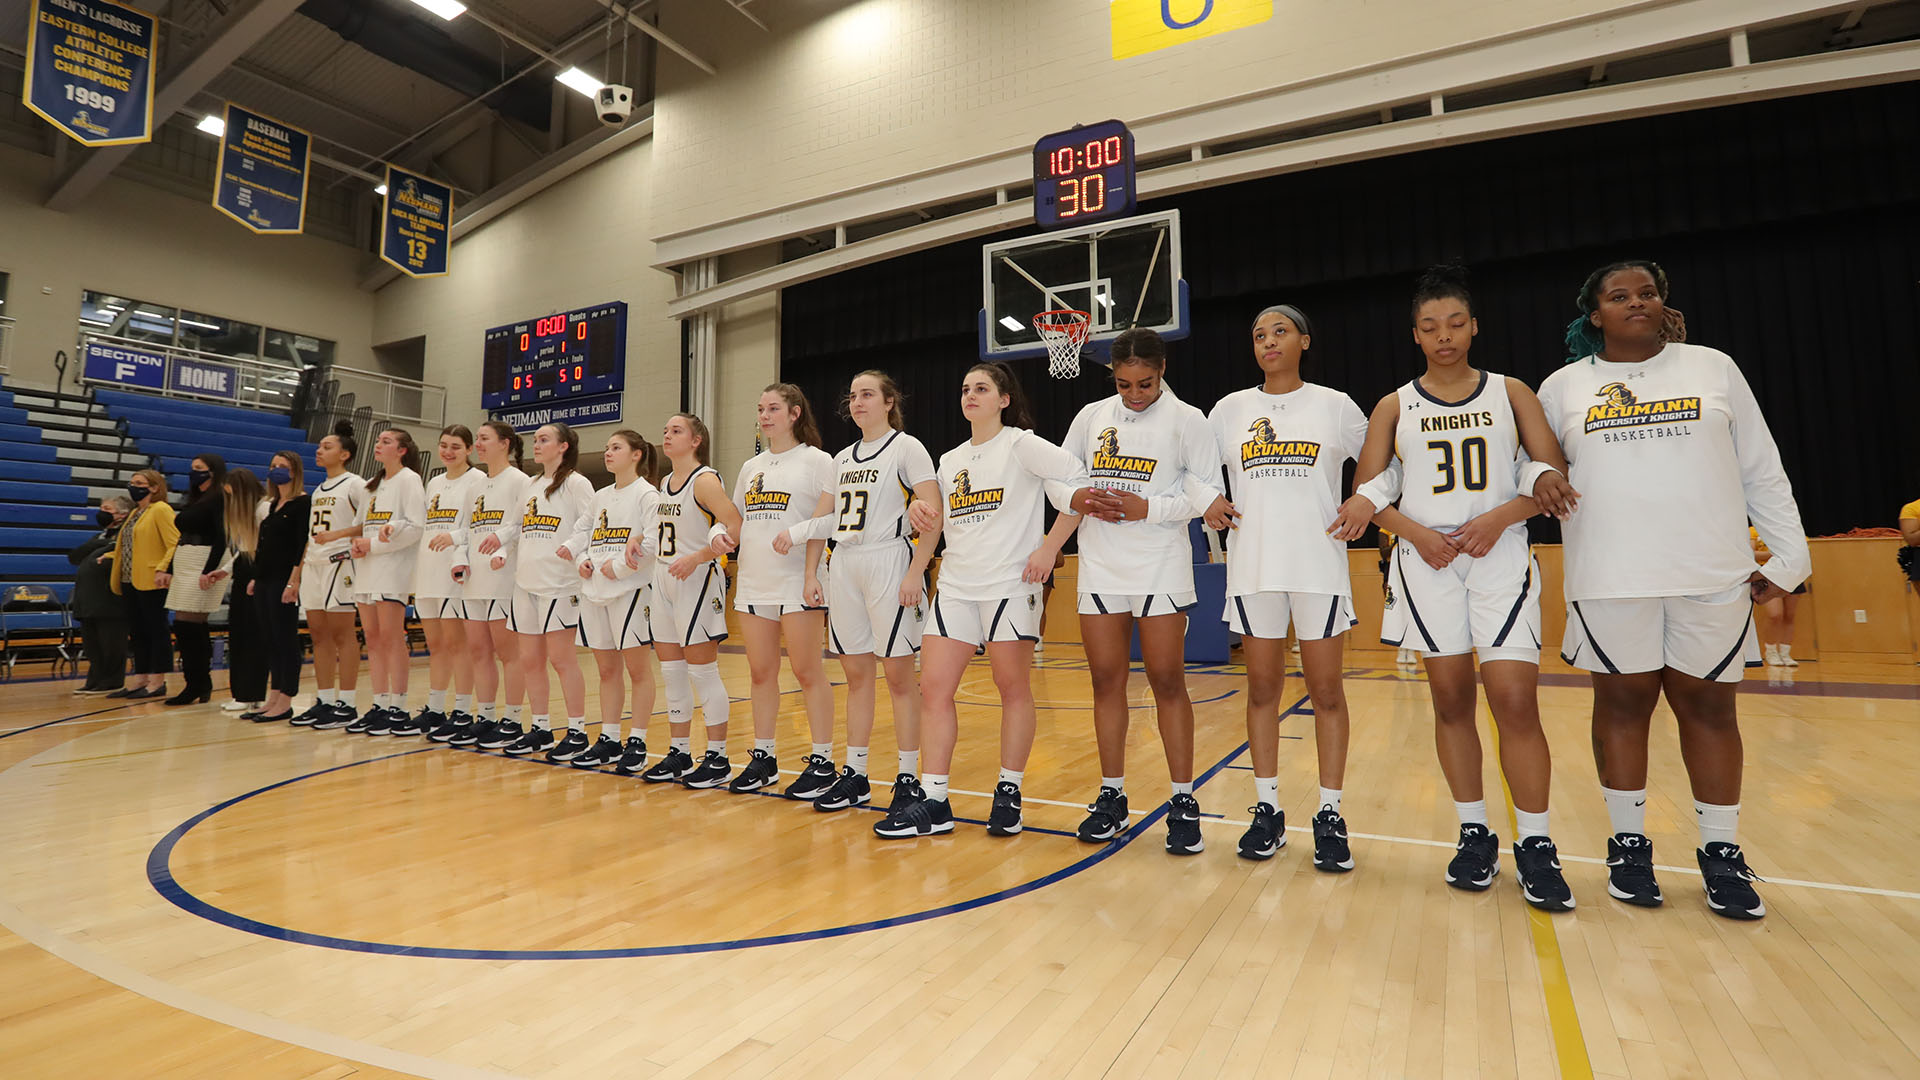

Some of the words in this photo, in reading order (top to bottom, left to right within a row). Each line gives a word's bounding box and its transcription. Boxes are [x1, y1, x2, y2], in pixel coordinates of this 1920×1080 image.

[89, 8, 142, 36] LACROSSE
[40, 11, 96, 40] EASTERN
[98, 32, 148, 58] COLLEGE
[65, 35, 123, 62] ATHLETIC
[53, 44, 132, 80] CONFERENCE
[54, 59, 130, 92] CHAMPIONS
[64, 84, 116, 113] 1999
[247, 118, 290, 143] BASEBALL
[1050, 136, 1120, 175] 10:00
[1060, 174, 1104, 217] 30
[410, 220, 427, 232] TEAM
[408, 239, 428, 260] 13
[536, 314, 566, 336] 10:00
[569, 312, 586, 322] Guests
[514, 325, 528, 334] Home
[577, 322, 587, 340] 0
[520, 333, 530, 352] 0
[540, 345, 554, 356] period
[561, 341, 566, 353] 1
[90, 346, 162, 368] SECTION
[539, 360, 554, 370] player
[115, 362, 136, 380] F
[180, 366, 228, 392] HOME
[514, 376, 522, 390] 0
[525, 374, 533, 388] 5
[560, 368, 567, 383] 5
[574, 366, 582, 380] 0
[539, 389, 552, 398] game
[552, 410, 568, 420] HOME
[569, 408, 576, 418] OF
[578, 406, 590, 416] THE
[591, 402, 618, 414] KNIGHTS
[1587, 398, 1698, 422] NEUMANN
[1420, 411, 1493, 432] KNIGHTS
[1586, 415, 1648, 430] UNIVERSITY
[1650, 411, 1697, 422] KNIGHTS
[1604, 426, 1692, 442] BASKETBALL
[1242, 442, 1318, 460] NEUMANN
[1282, 456, 1314, 464] KNIGHTS
[1093, 452, 1155, 472] NEUMANN
[1427, 436, 1488, 495] 30
[840, 470, 879, 485] KNIGHTS
[1120, 471, 1150, 480] KNIGHTS
[1250, 468, 1308, 480] BASKETBALL
[314, 497, 336, 506] IGHTS
[746, 492, 790, 505] NEUMANN
[949, 490, 1002, 510] NEUMANN
[838, 490, 868, 532] 23
[312, 510, 332, 536] 25
[658, 522, 676, 556] 13
